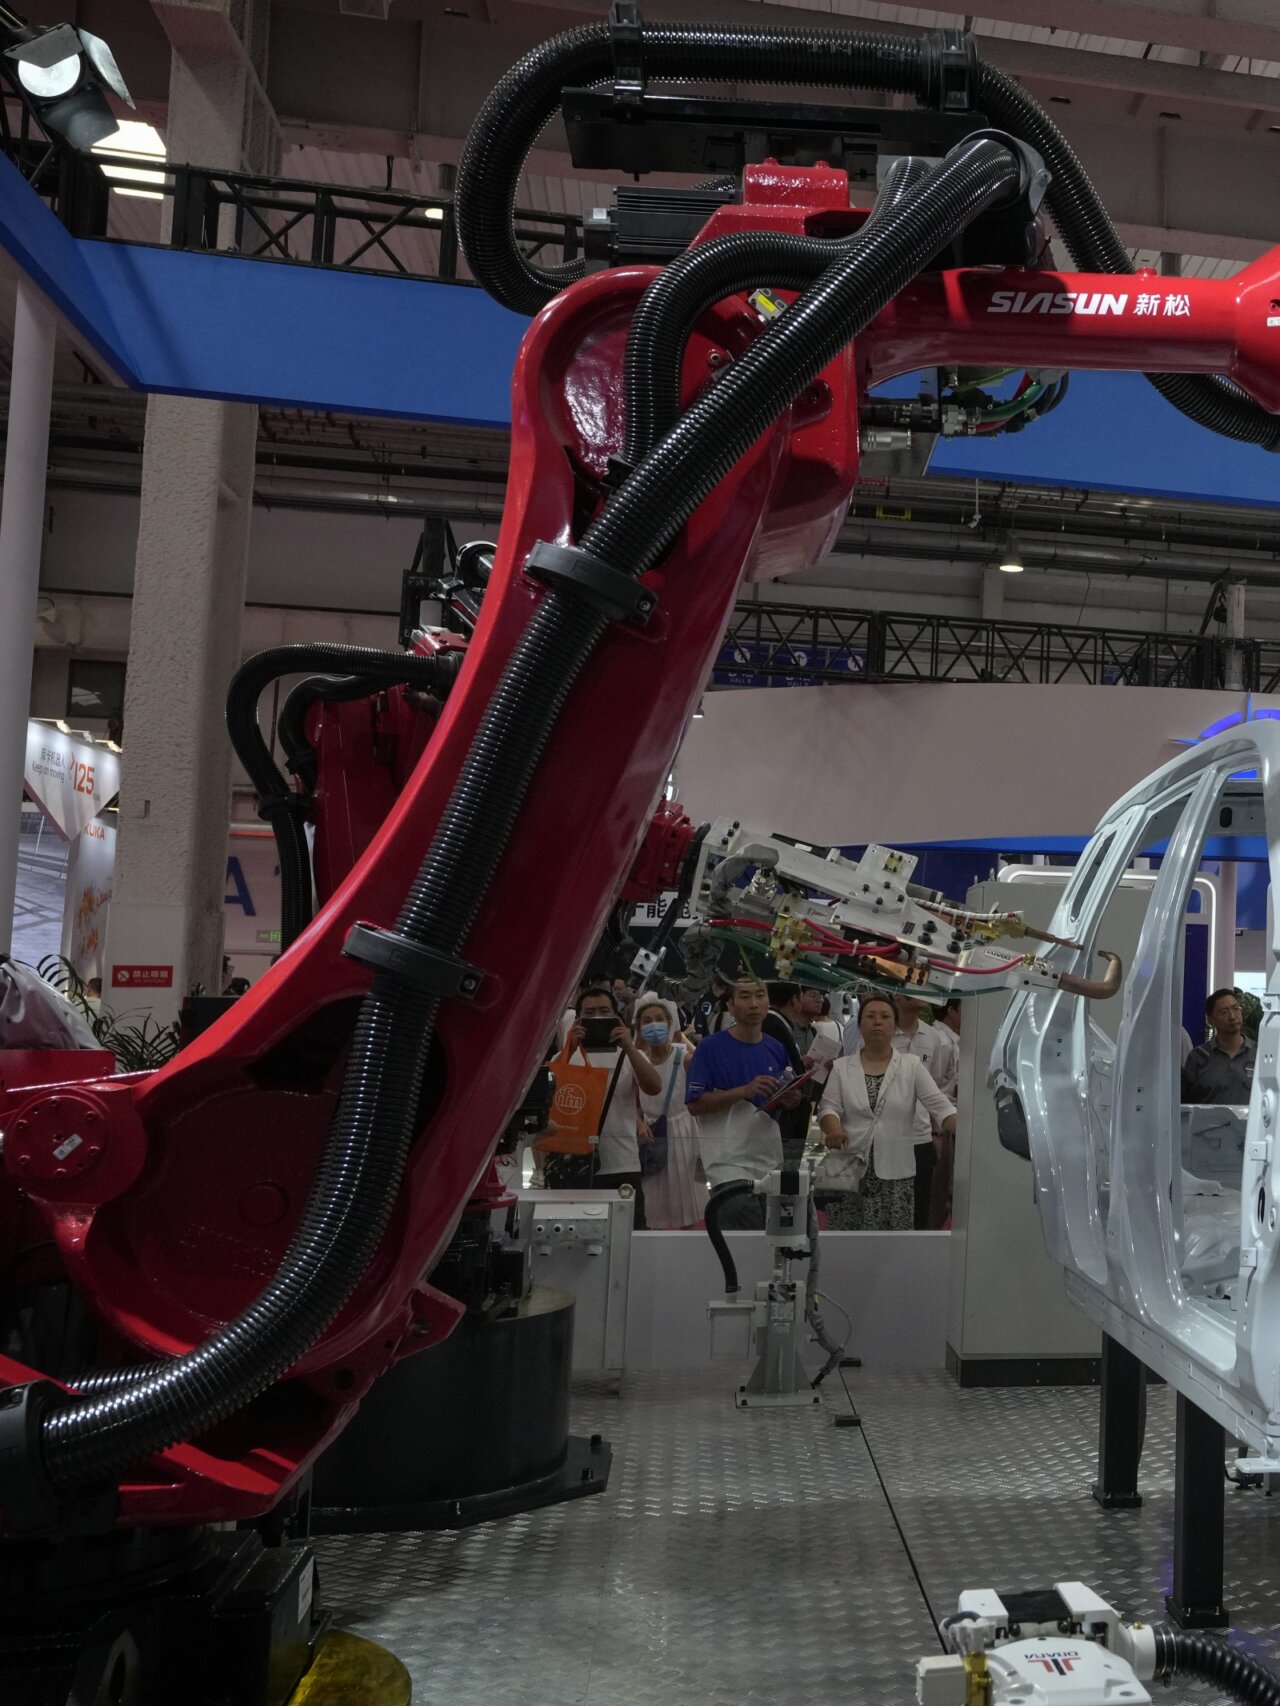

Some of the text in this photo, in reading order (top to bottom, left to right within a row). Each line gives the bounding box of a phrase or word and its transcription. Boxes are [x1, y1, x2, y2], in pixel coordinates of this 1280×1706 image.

[987, 291, 1191, 317] SIASUN 新松
[83, 822, 105, 840] KUKA
